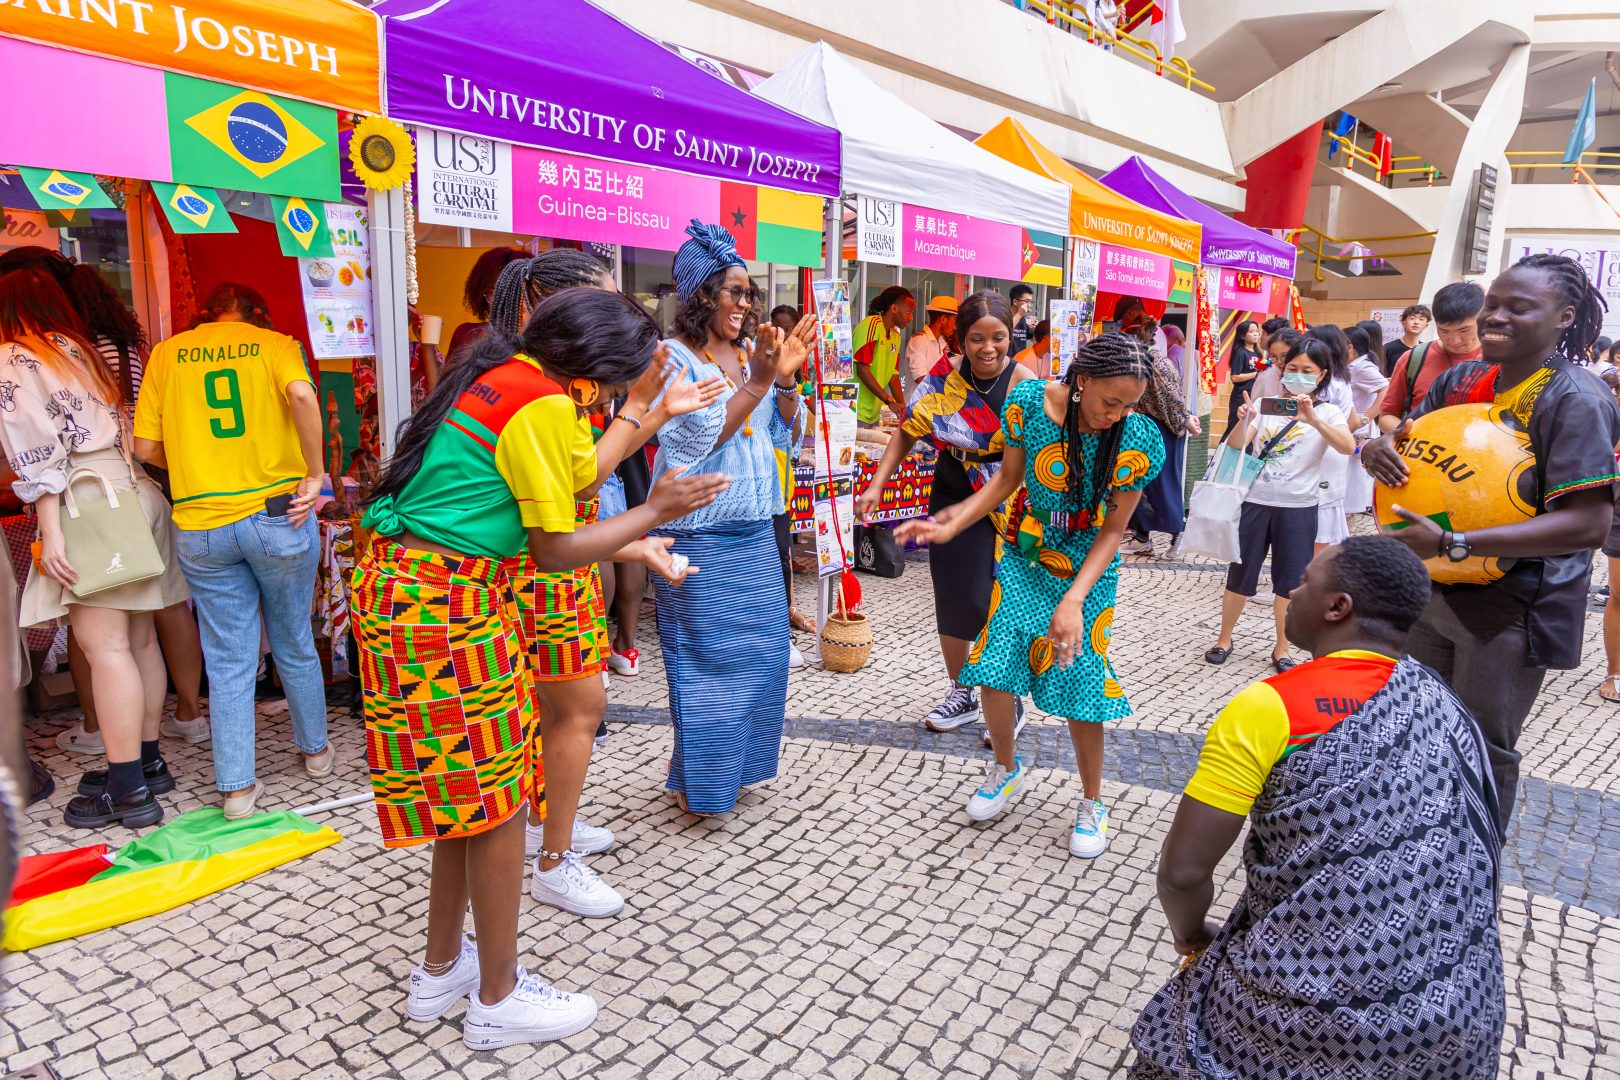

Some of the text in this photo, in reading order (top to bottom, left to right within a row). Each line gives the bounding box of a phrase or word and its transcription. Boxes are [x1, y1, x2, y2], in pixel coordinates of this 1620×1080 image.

[169, 4, 341, 77] JOSEPH
[443, 74, 821, 183] UNIVERSITY OF SAINT JOSEPH
[431, 129, 497, 176] USJ
[433, 172, 498, 189] INTERNATIONAL
[433, 180, 498, 201] CULTURAL
[433, 192, 499, 212] CARNIVAL
[538, 194, 670, 230] Guinea-Bissau
[864, 198, 896, 228] USJ
[914, 214, 958, 238] 莫桑比克
[1083, 211, 1133, 239] UNIVERSITY
[1134, 226, 1146, 241] OF
[914, 239, 977, 261] Mozambique
[1105, 269, 1117, 280] São
[1118, 271, 1133, 284] Tomé
[177, 343, 260, 363] RONALDO
[204, 368, 246, 439] 9
[1396, 437, 1476, 483] BISSAU
